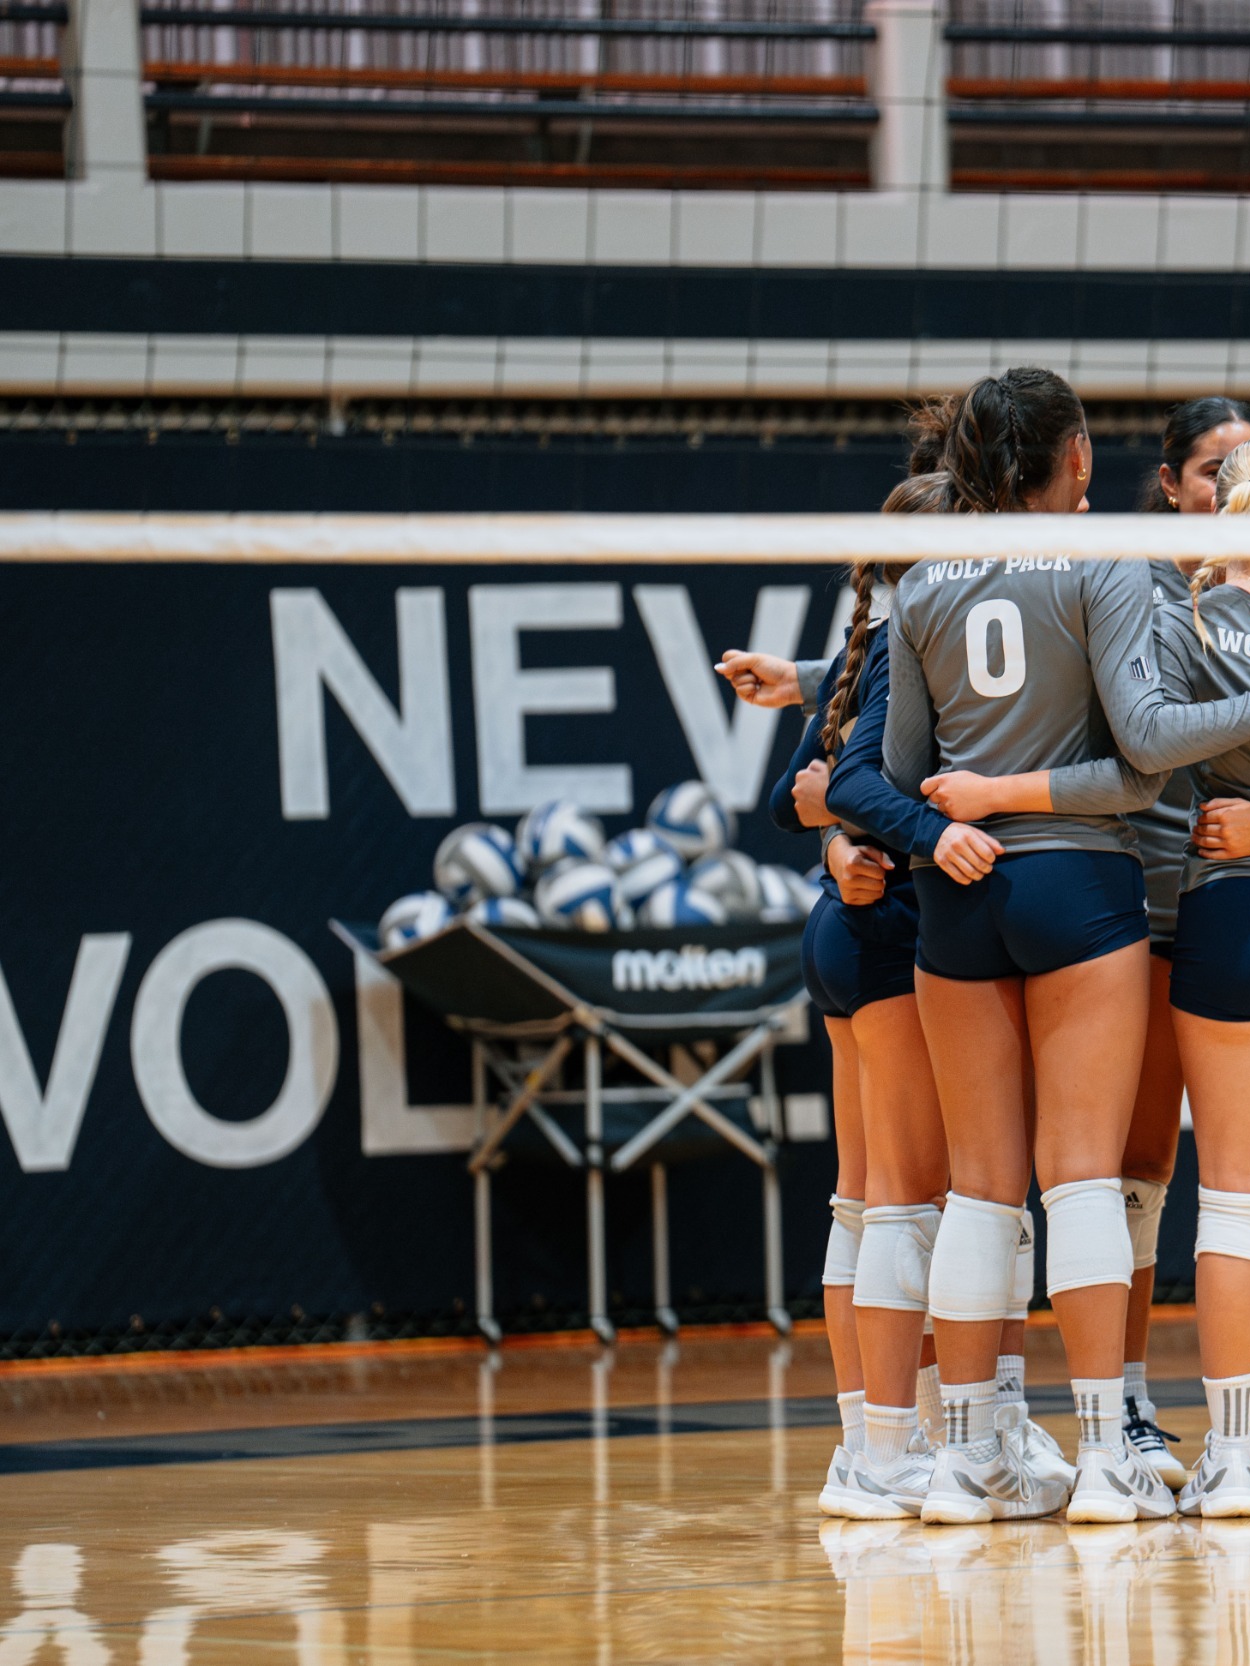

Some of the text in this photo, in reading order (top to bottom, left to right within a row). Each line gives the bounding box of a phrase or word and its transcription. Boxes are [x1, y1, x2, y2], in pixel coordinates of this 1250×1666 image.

[927, 552, 1072, 585] WOLF PACK
[965, 599, 1027, 698] 0
[612, 945, 767, 992] molten
[0, 916, 829, 1173] VOL
